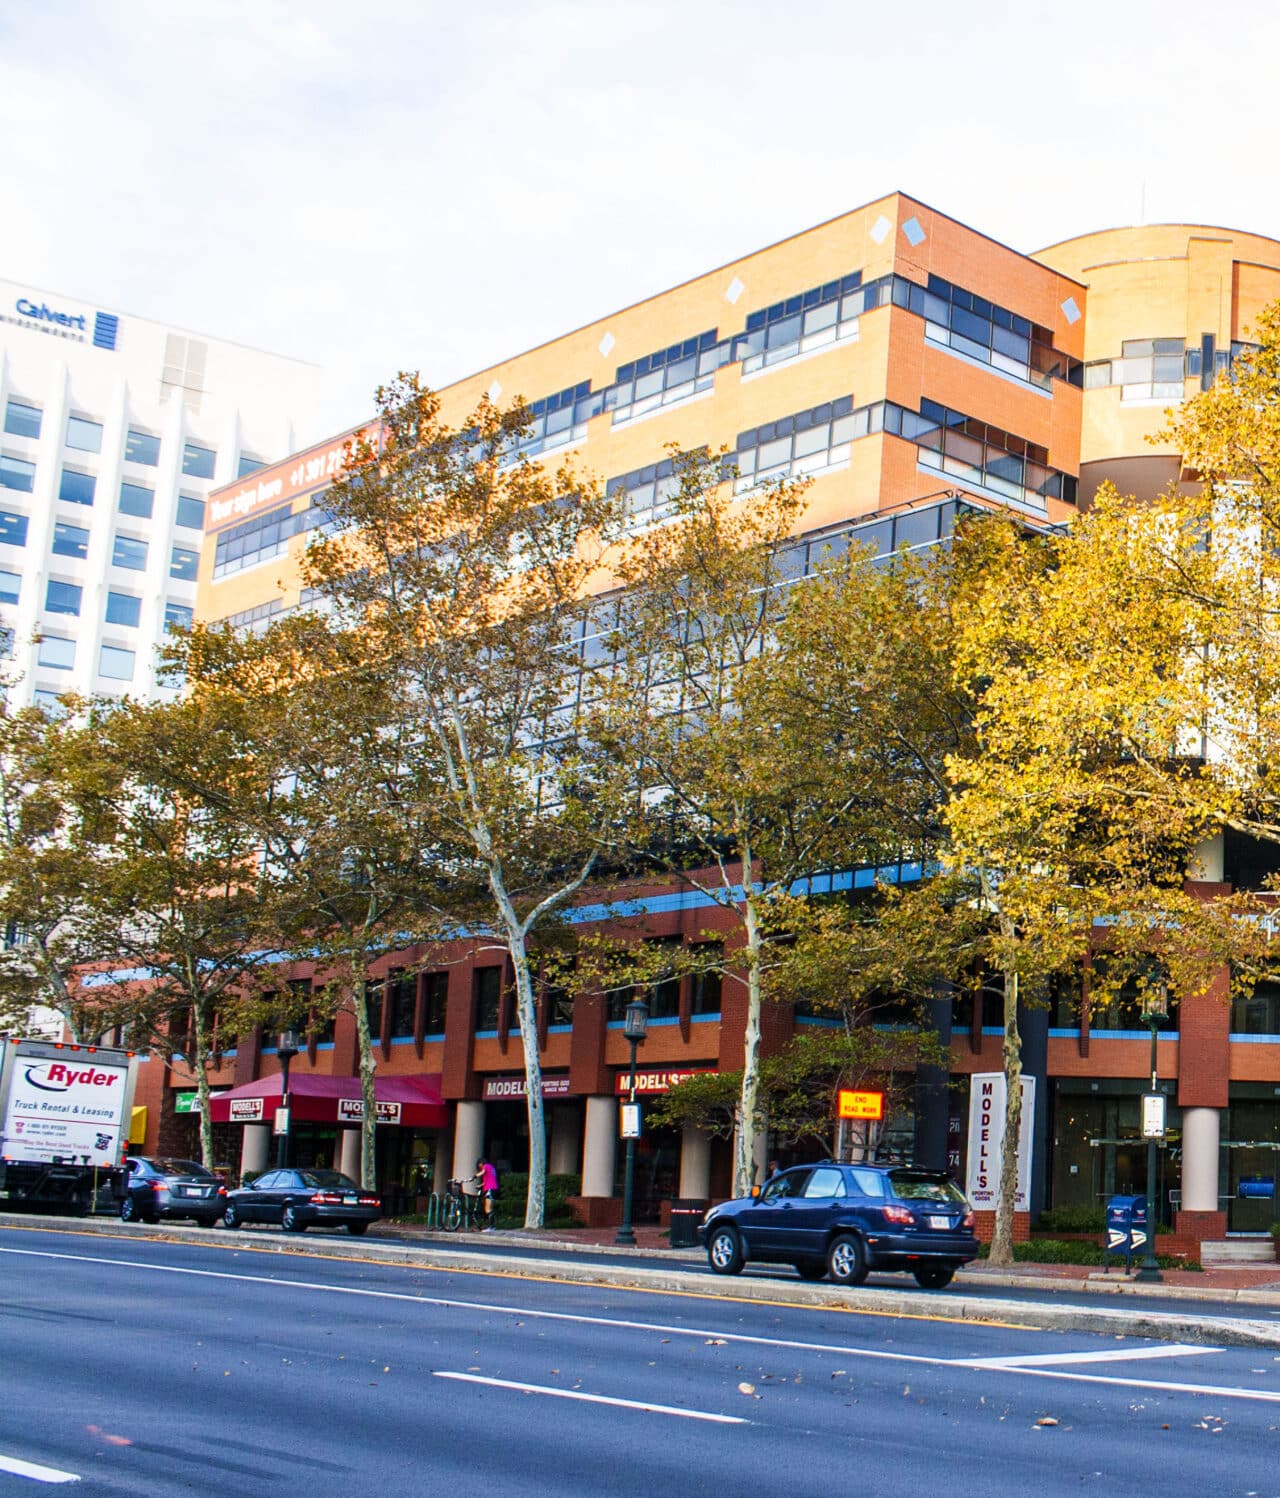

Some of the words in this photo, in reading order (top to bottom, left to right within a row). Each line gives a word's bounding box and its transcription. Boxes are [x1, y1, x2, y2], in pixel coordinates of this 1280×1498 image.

[16, 298, 85, 331] Calvert
[211, 498, 234, 522] Your
[233, 487, 256, 514] sign
[258, 478, 282, 503] here
[47, 1063, 119, 1087] Ryder
[15, 1099, 38, 1111] Truck
[41, 1102, 70, 1113] Rental
[72, 1105, 79, 1114] &
[81, 1106, 114, 1119] Leasing
[343, 1102, 396, 1114] MOLL'S
[855, 1096, 867, 1104] END
[976, 1082, 993, 1189] MODELL'S
